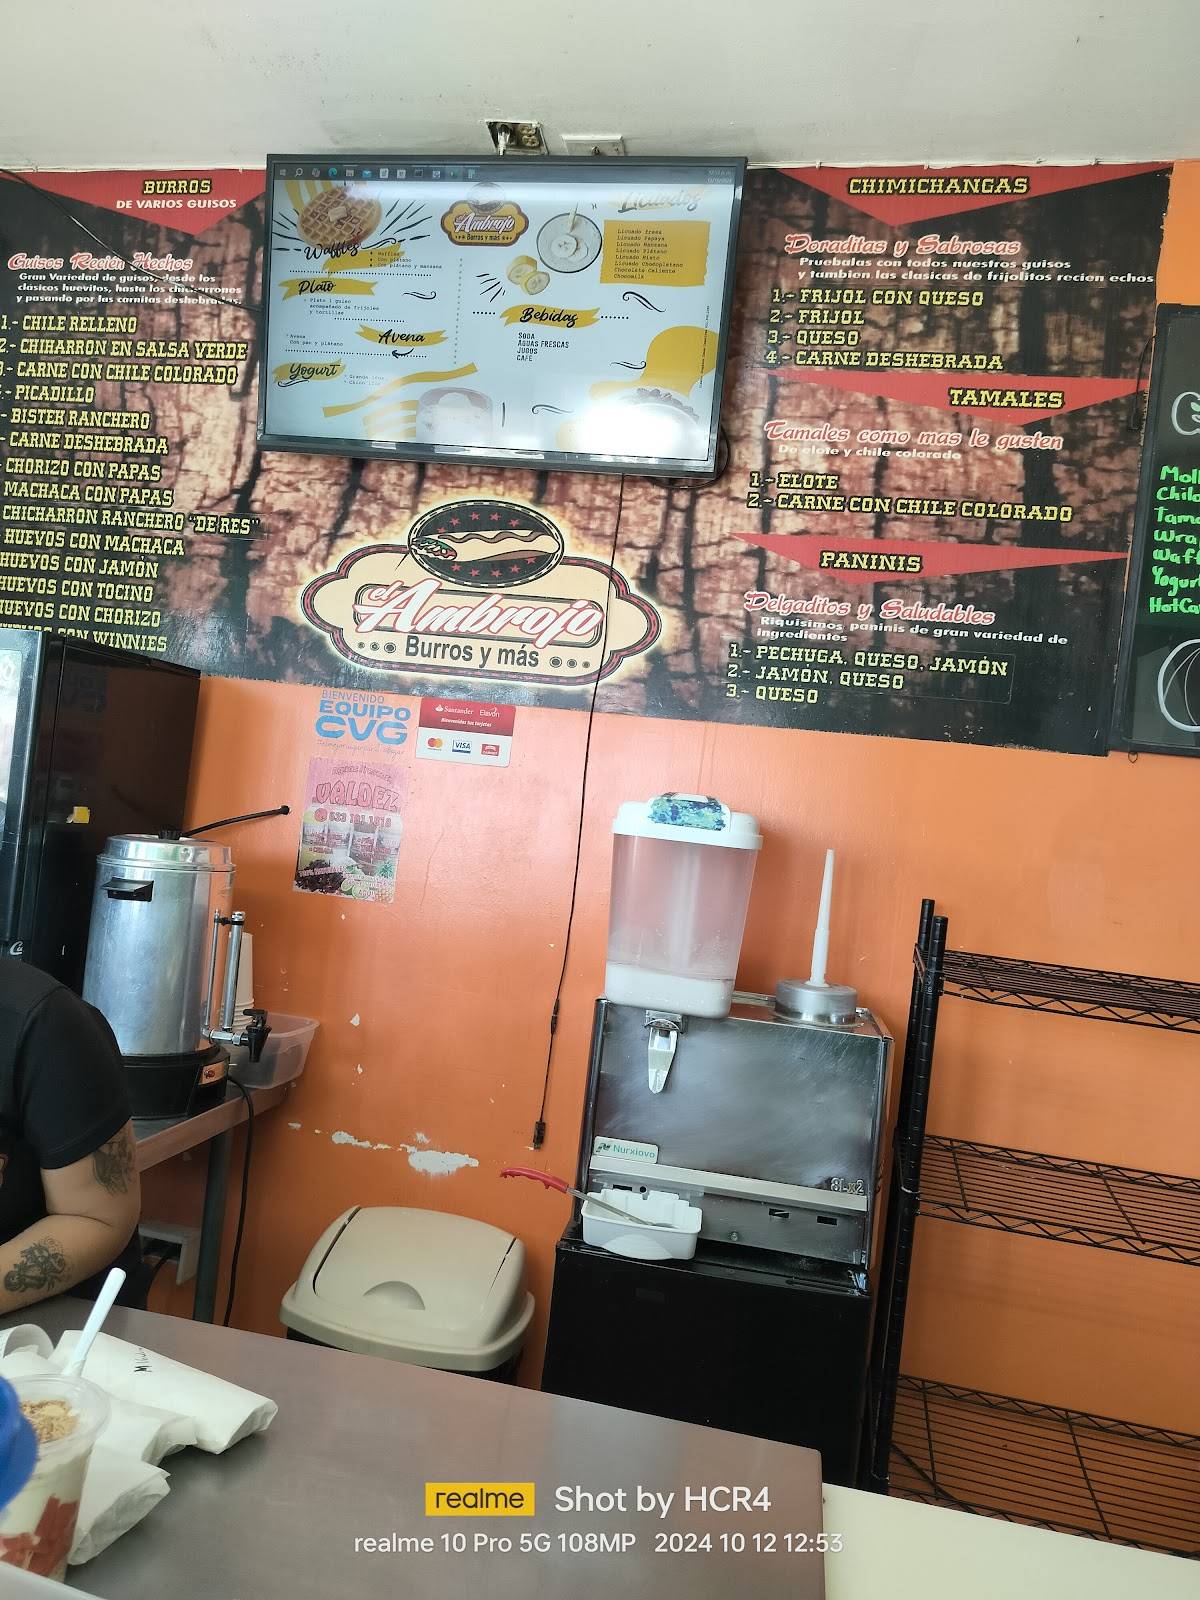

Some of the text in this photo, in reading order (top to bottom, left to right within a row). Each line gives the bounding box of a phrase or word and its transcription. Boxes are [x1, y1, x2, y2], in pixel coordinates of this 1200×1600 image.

[144, 180, 211, 194] BURROS
[850, 178, 1028, 194] CHIMICHANGAS
[116, 200, 236, 208] DE VARIOS GUISOS
[454, 212, 514, 234] Ambrojo
[304, 241, 362, 260] Waffles
[785, 234, 1022, 258] Doraditas y Sabrosas
[8, 252, 194, 272] Guisos Recién Hechos
[800, 258, 872, 266] Pruebalas
[906, 258, 948, 268] todos
[952, 260, 1017, 268] nuestros
[1022, 260, 1072, 270] guisos
[19, 272, 216, 285] Gran Variedad de guisos, desde los
[810, 270, 1154, 283] tambien las clasicas de frijolitos recien echos
[18, 283, 166, 294] clásicos huevitos, hasta los
[298, 280, 336, 295] Plato
[800, 289, 984, 306] FRIJOL CON QUESO
[25, 294, 161, 304] pasando por las carnitas
[22, 315, 138, 333] CHILE RELLENO
[520, 307, 578, 328] Bebidas
[798, 309, 864, 324] FRIJOL
[378, 329, 426, 344] Avena
[796, 330, 859, 345] QUESO
[20, 338, 248, 360] CHIHARRON EN SALSA VERDE
[796, 351, 1004, 370] CARNE DESHEBRADA
[17, 362, 238, 384] CARNE CON CHILE COLORADO
[289, 363, 341, 380] Yogurt
[15, 385, 95, 403] PICADILLO
[950, 388, 1064, 409] TAMALES
[11, 408, 150, 429] BISTEK RANCHERO
[10, 432, 169, 454] CARNE DESHEBRADA
[764, 420, 1064, 452] Tamales como mas le gusten
[801, 446, 840, 456] elote
[856, 447, 891, 457] chile
[895, 448, 962, 460] colorado
[6, 457, 161, 481] CHORIZO CON PAPAS
[778, 472, 839, 490] ELOTE
[4, 481, 173, 506] MACHACA CON PAPAS
[2, 505, 184, 530] CHICHARRON RANCHERO
[777, 494, 1073, 522] CARNE CON CHILE COLORADO
[4, 528, 184, 556] HUEVOS CON MACHACA
[0, 552, 159, 578] HUEVOS CON JAMÓN
[821, 550, 922, 573] PANINIS
[61, 580, 93, 598] CON
[98, 582, 153, 602] TOCINO
[58, 604, 161, 627] CON CHORIZO
[353, 578, 604, 648] el Ambrojo
[744, 591, 996, 626] Delgaditos y Saludables
[93, 630, 168, 652] WINNIES
[756, 628, 848, 642] ingredientes
[761, 617, 1069, 645] Riquisimos paninis de gran variedad de
[405, 636, 539, 669] Burros y más
[755, 645, 1008, 676] PECHUGA, QUESO, JAMÓN
[840, 672, 904, 690] QUESO
[322, 690, 385, 704] BIENVENIDO
[755, 686, 818, 704] QUESO
[320, 700, 411, 721] EQUIPO
[444, 706, 474, 715] Santander
[315, 715, 408, 745] CVG
[456, 742, 471, 750] VISA
[315, 780, 400, 812] VALDEZ
